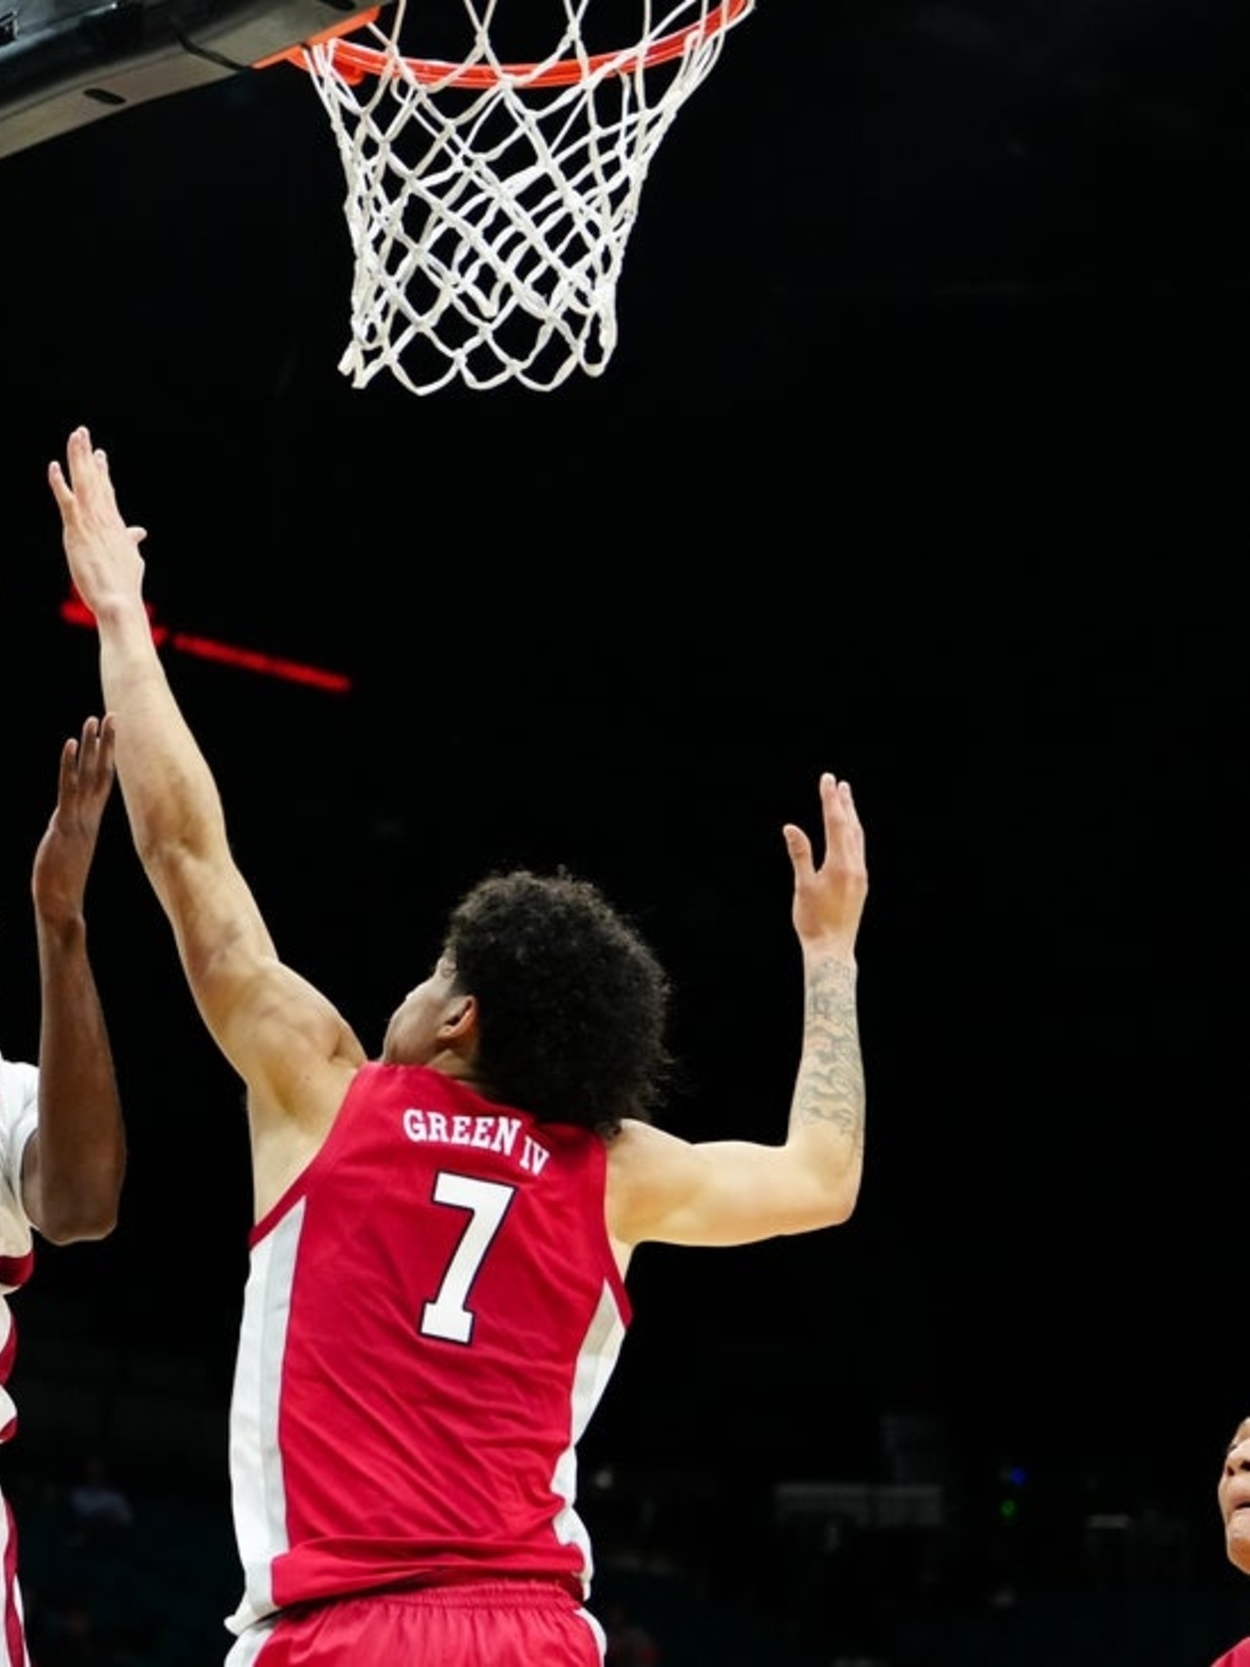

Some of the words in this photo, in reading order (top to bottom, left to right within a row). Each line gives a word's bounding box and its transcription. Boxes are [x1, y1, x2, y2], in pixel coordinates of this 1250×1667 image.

[402, 1108, 522, 1157] GREEN
[519, 1135, 550, 1177] IV
[419, 1169, 518, 1346] 7
